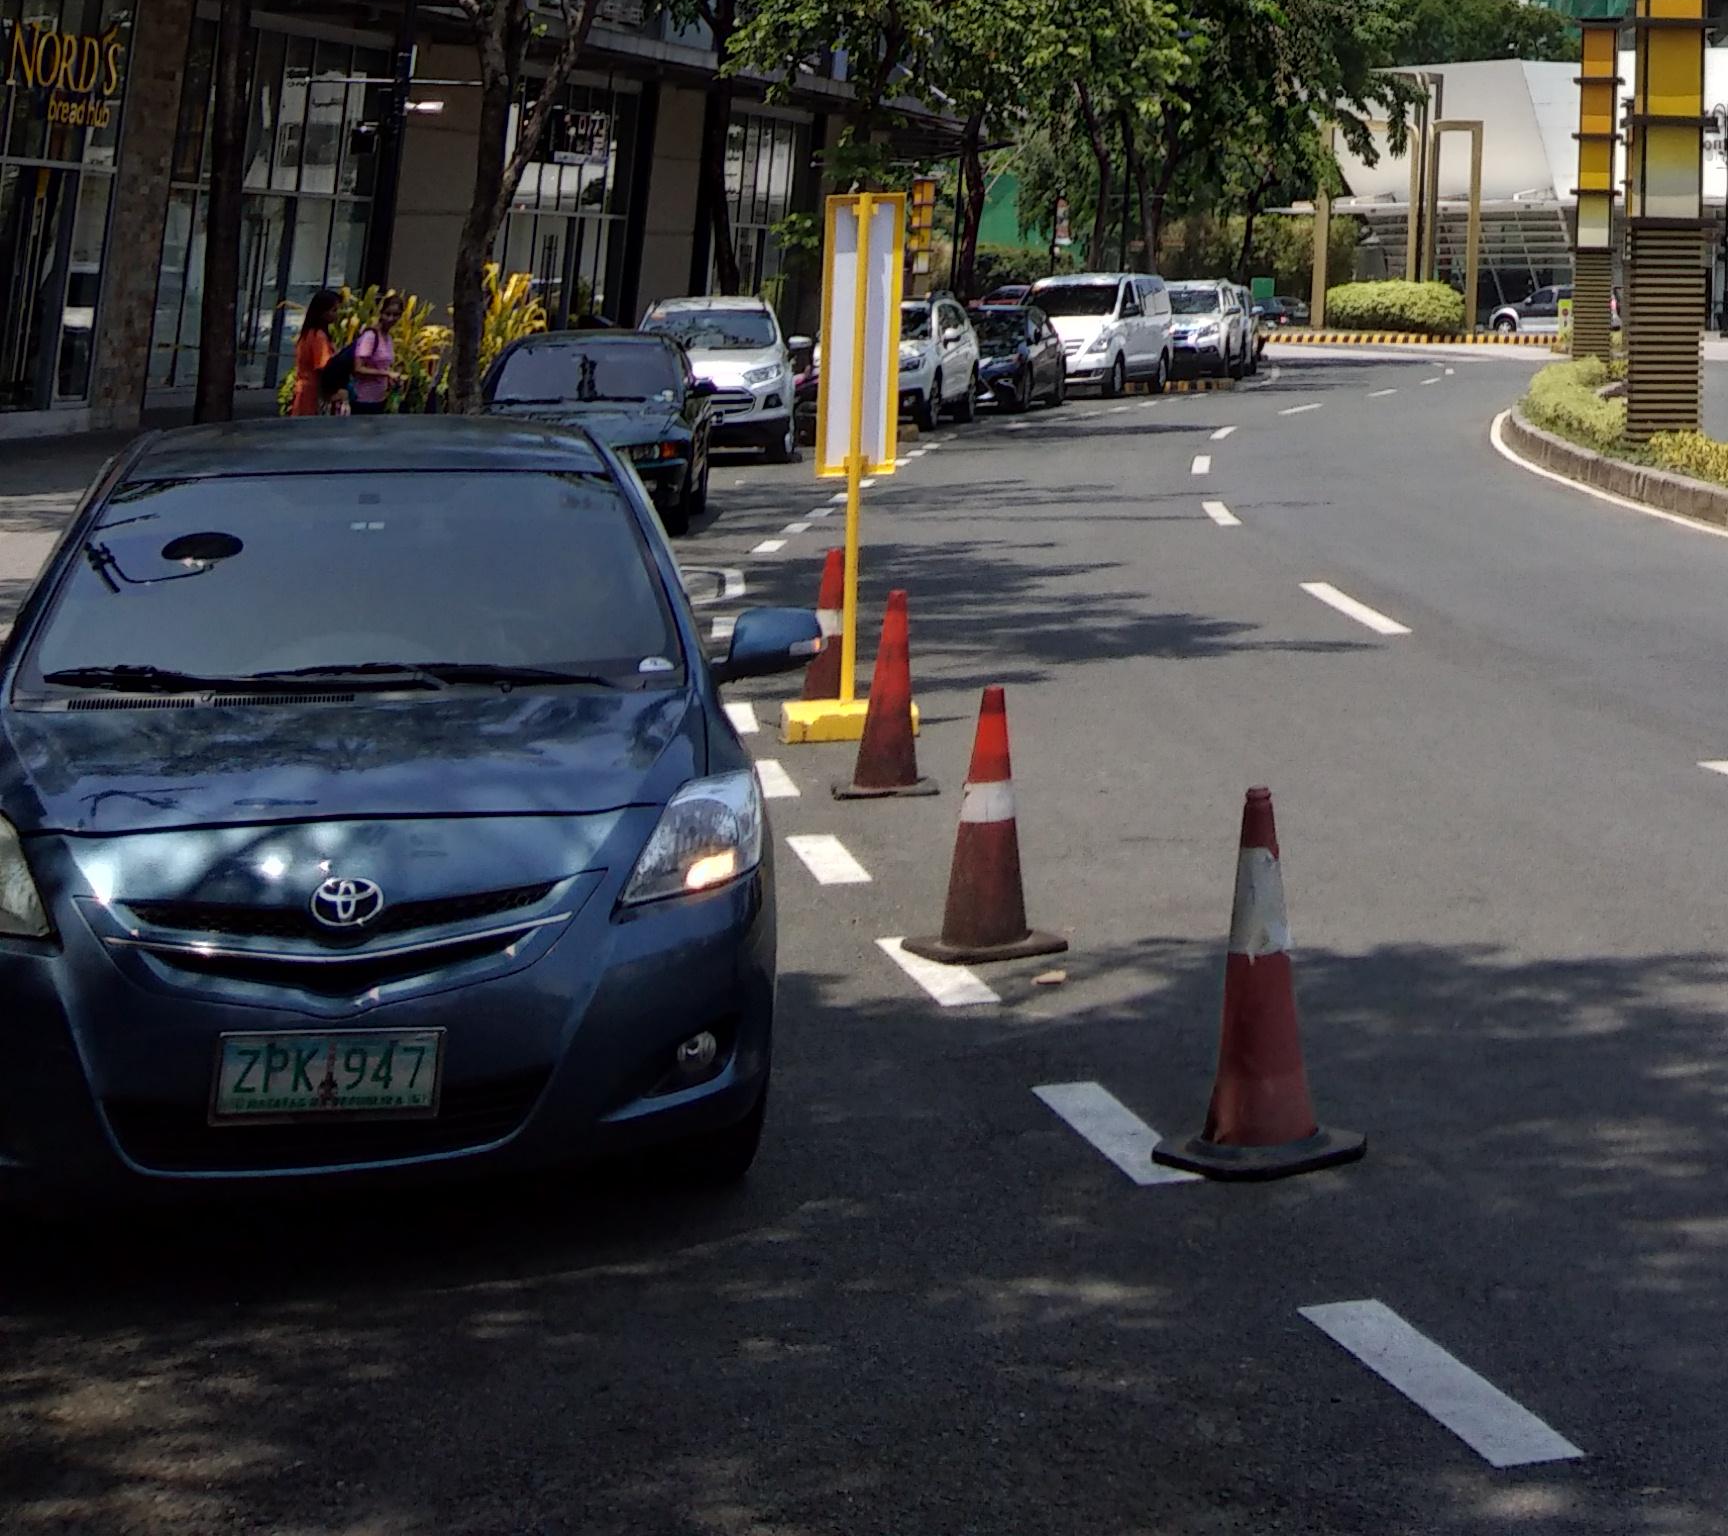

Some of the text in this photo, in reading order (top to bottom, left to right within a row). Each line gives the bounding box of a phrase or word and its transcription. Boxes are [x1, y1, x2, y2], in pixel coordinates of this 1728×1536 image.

[7, 19, 124, 96] NORD'S
[48, 91, 109, 128] bread hub
[233, 1044, 425, 1093] ZPK 947
